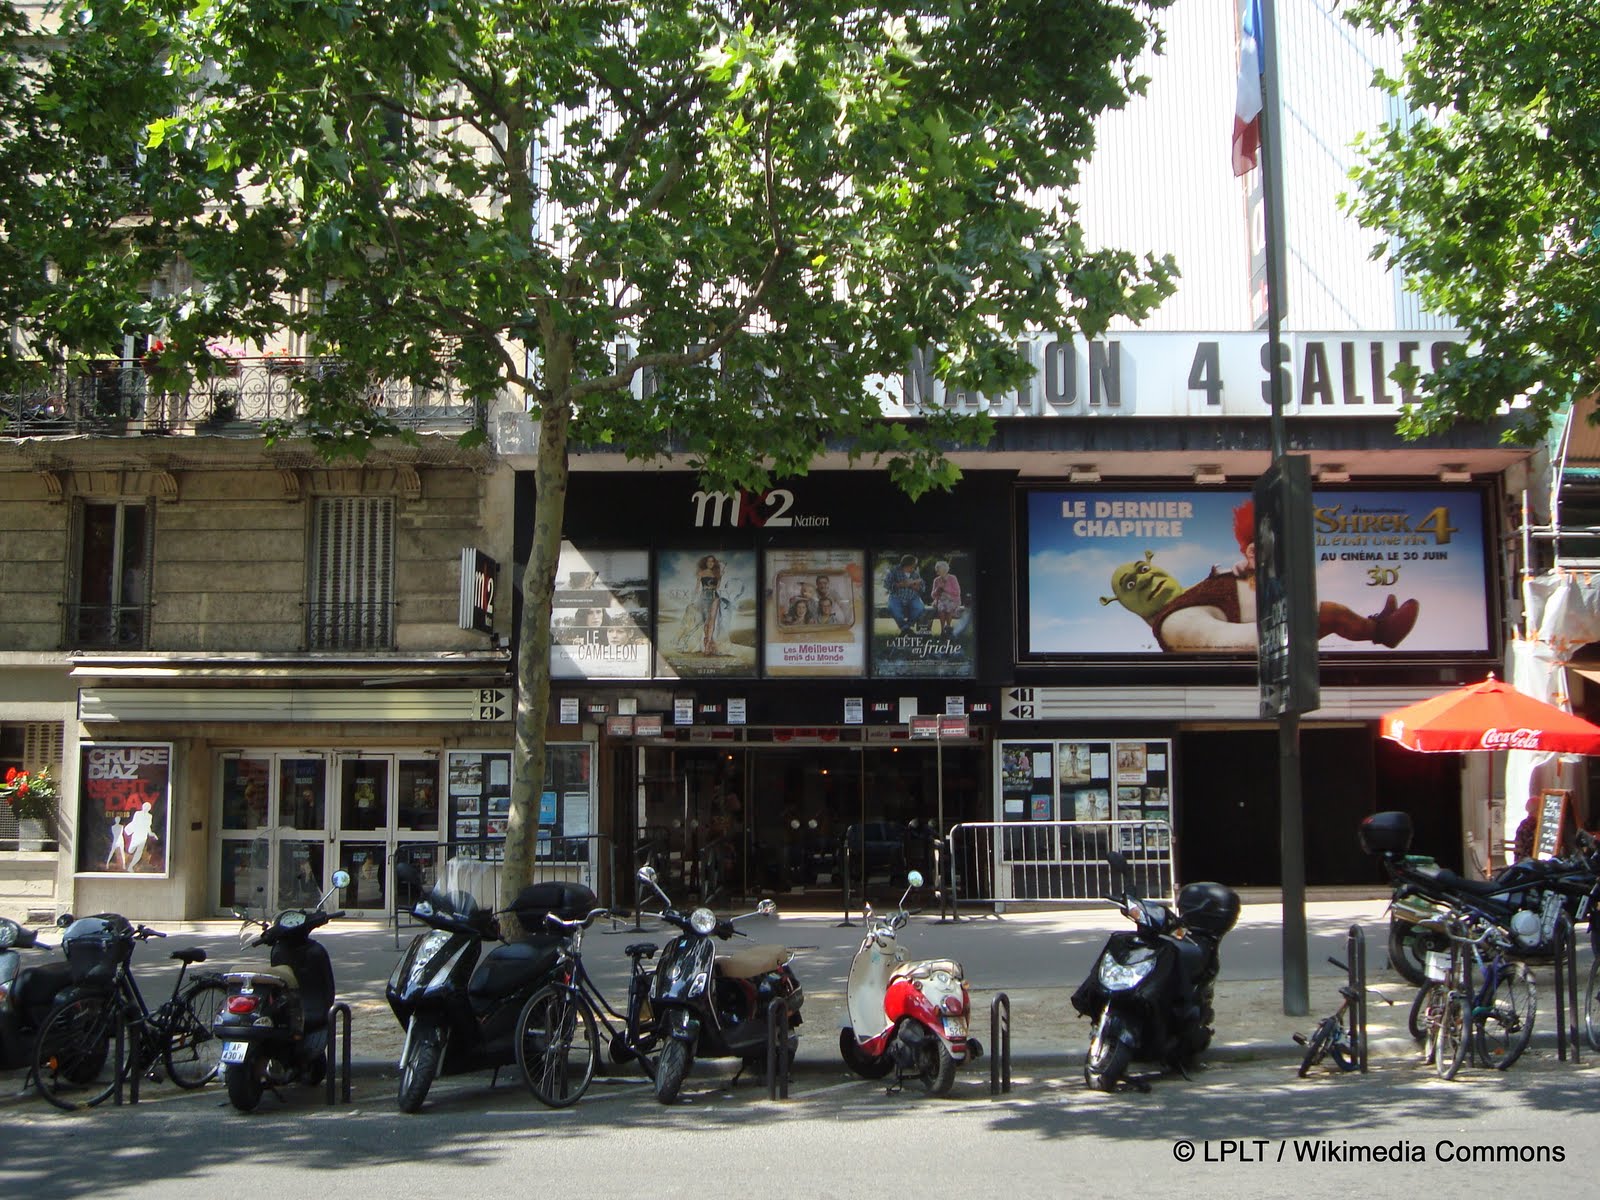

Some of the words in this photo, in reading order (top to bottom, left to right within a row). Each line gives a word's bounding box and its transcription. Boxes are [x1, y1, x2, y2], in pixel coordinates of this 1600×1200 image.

[903, 341, 1121, 406] NION
[1188, 341, 1223, 405] 4
[1062, 501, 1086, 518] LE
[1095, 501, 1193, 518] DERNIER
[794, 515, 830, 527] Nation
[1073, 520, 1184, 537] CHAPITRE
[1414, 506, 1459, 545] 4
[1321, 552, 1337, 561] AU
[1341, 550, 1384, 561] CINÉMA
[1388, 552, 1399, 561] LE
[1403, 552, 1418, 561] 30
[1422, 552, 1448, 561] JUIN
[1366, 565, 1402, 587] 3D
[586, 630, 600, 646] LE
[784, 646, 797, 654] Les
[799, 644, 844, 654] Meilleurs
[920, 639, 962, 658] friche
[482, 690, 492, 702] 3
[1023, 689, 1031, 701] 1
[481, 707, 492, 719] 4
[1021, 705, 1032, 718] 2
[88, 748, 168, 765] CRUISE
[88, 764, 138, 779] DIAZ
[105, 792, 159, 811] DAY
